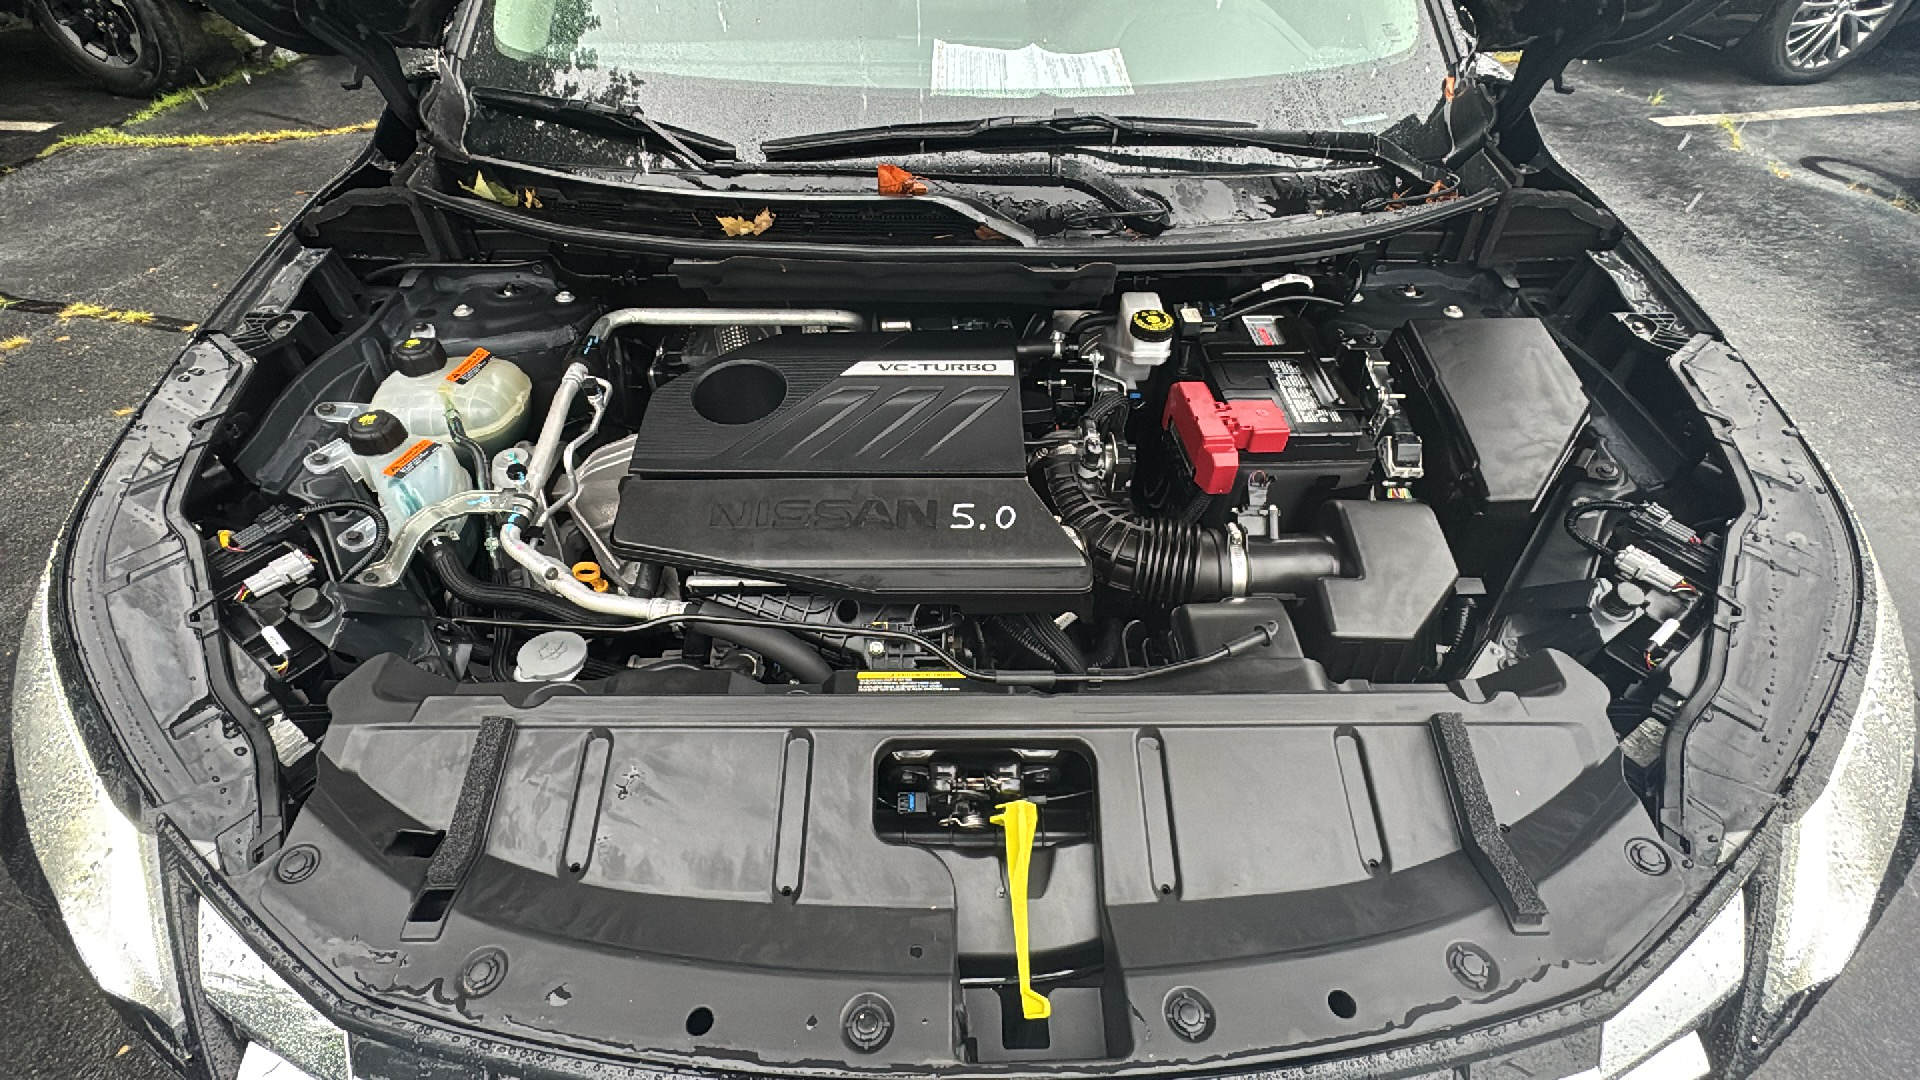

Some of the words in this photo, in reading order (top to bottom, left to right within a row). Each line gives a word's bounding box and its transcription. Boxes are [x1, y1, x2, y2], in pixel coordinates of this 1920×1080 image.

[877, 363, 998, 372] VC-TURBO
[709, 498, 937, 530] NISSAN
[949, 503, 1017, 530] 5.0
